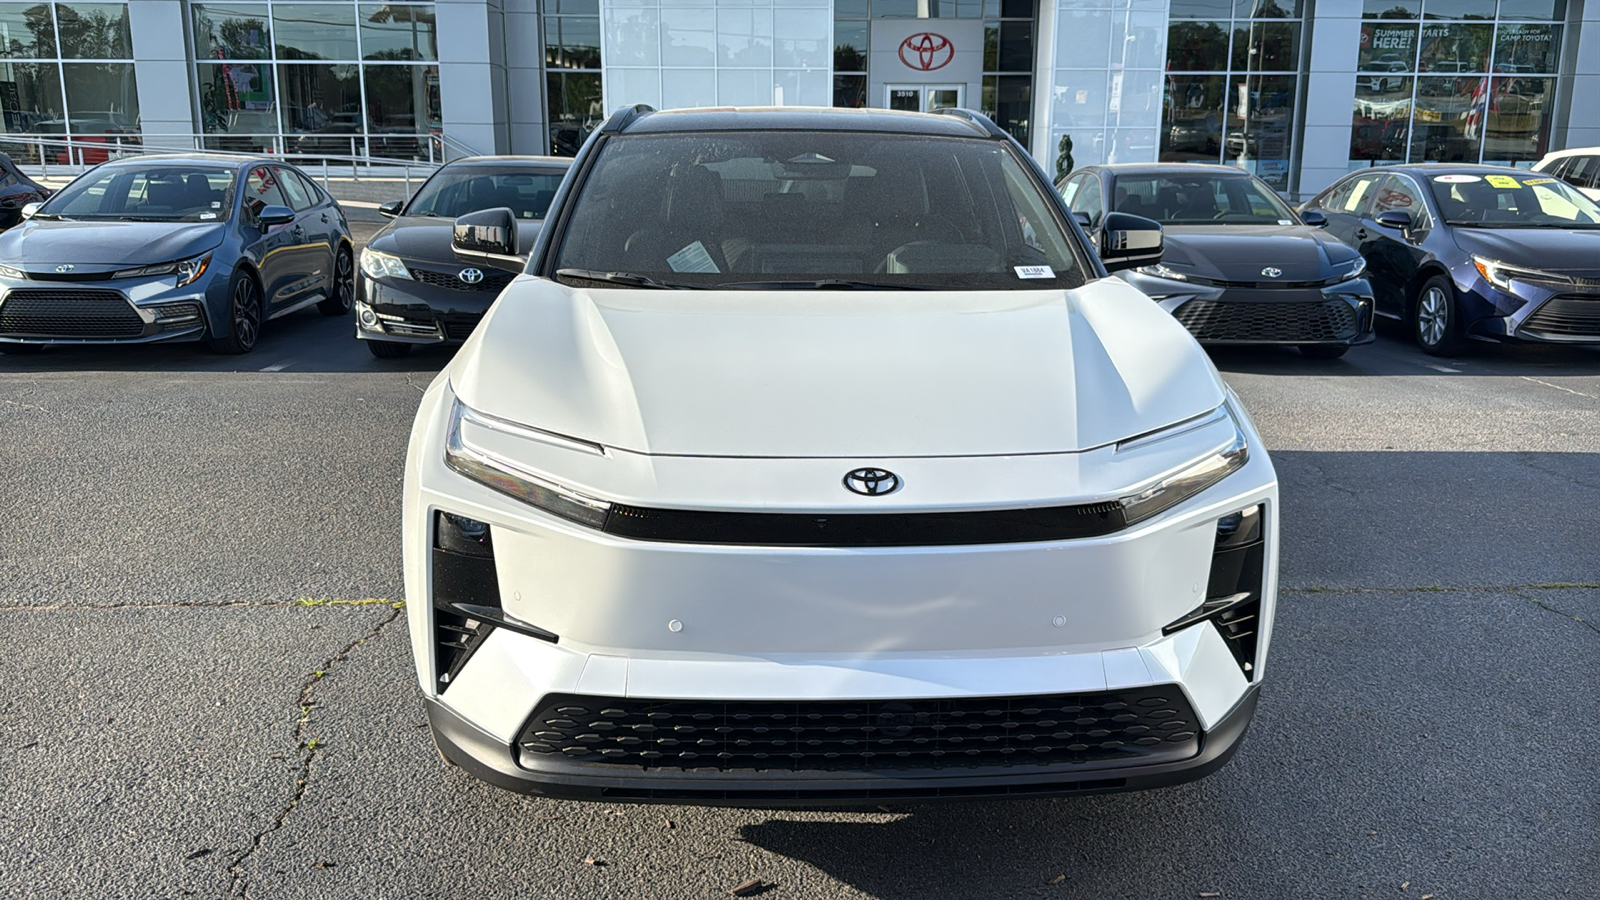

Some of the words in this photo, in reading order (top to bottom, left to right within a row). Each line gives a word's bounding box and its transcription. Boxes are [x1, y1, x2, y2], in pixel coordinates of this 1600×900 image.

[1374, 28, 1415, 37] SUMMER
[1421, 28, 1450, 37] TARTS
[1372, 37, 1412, 49] HERE!
